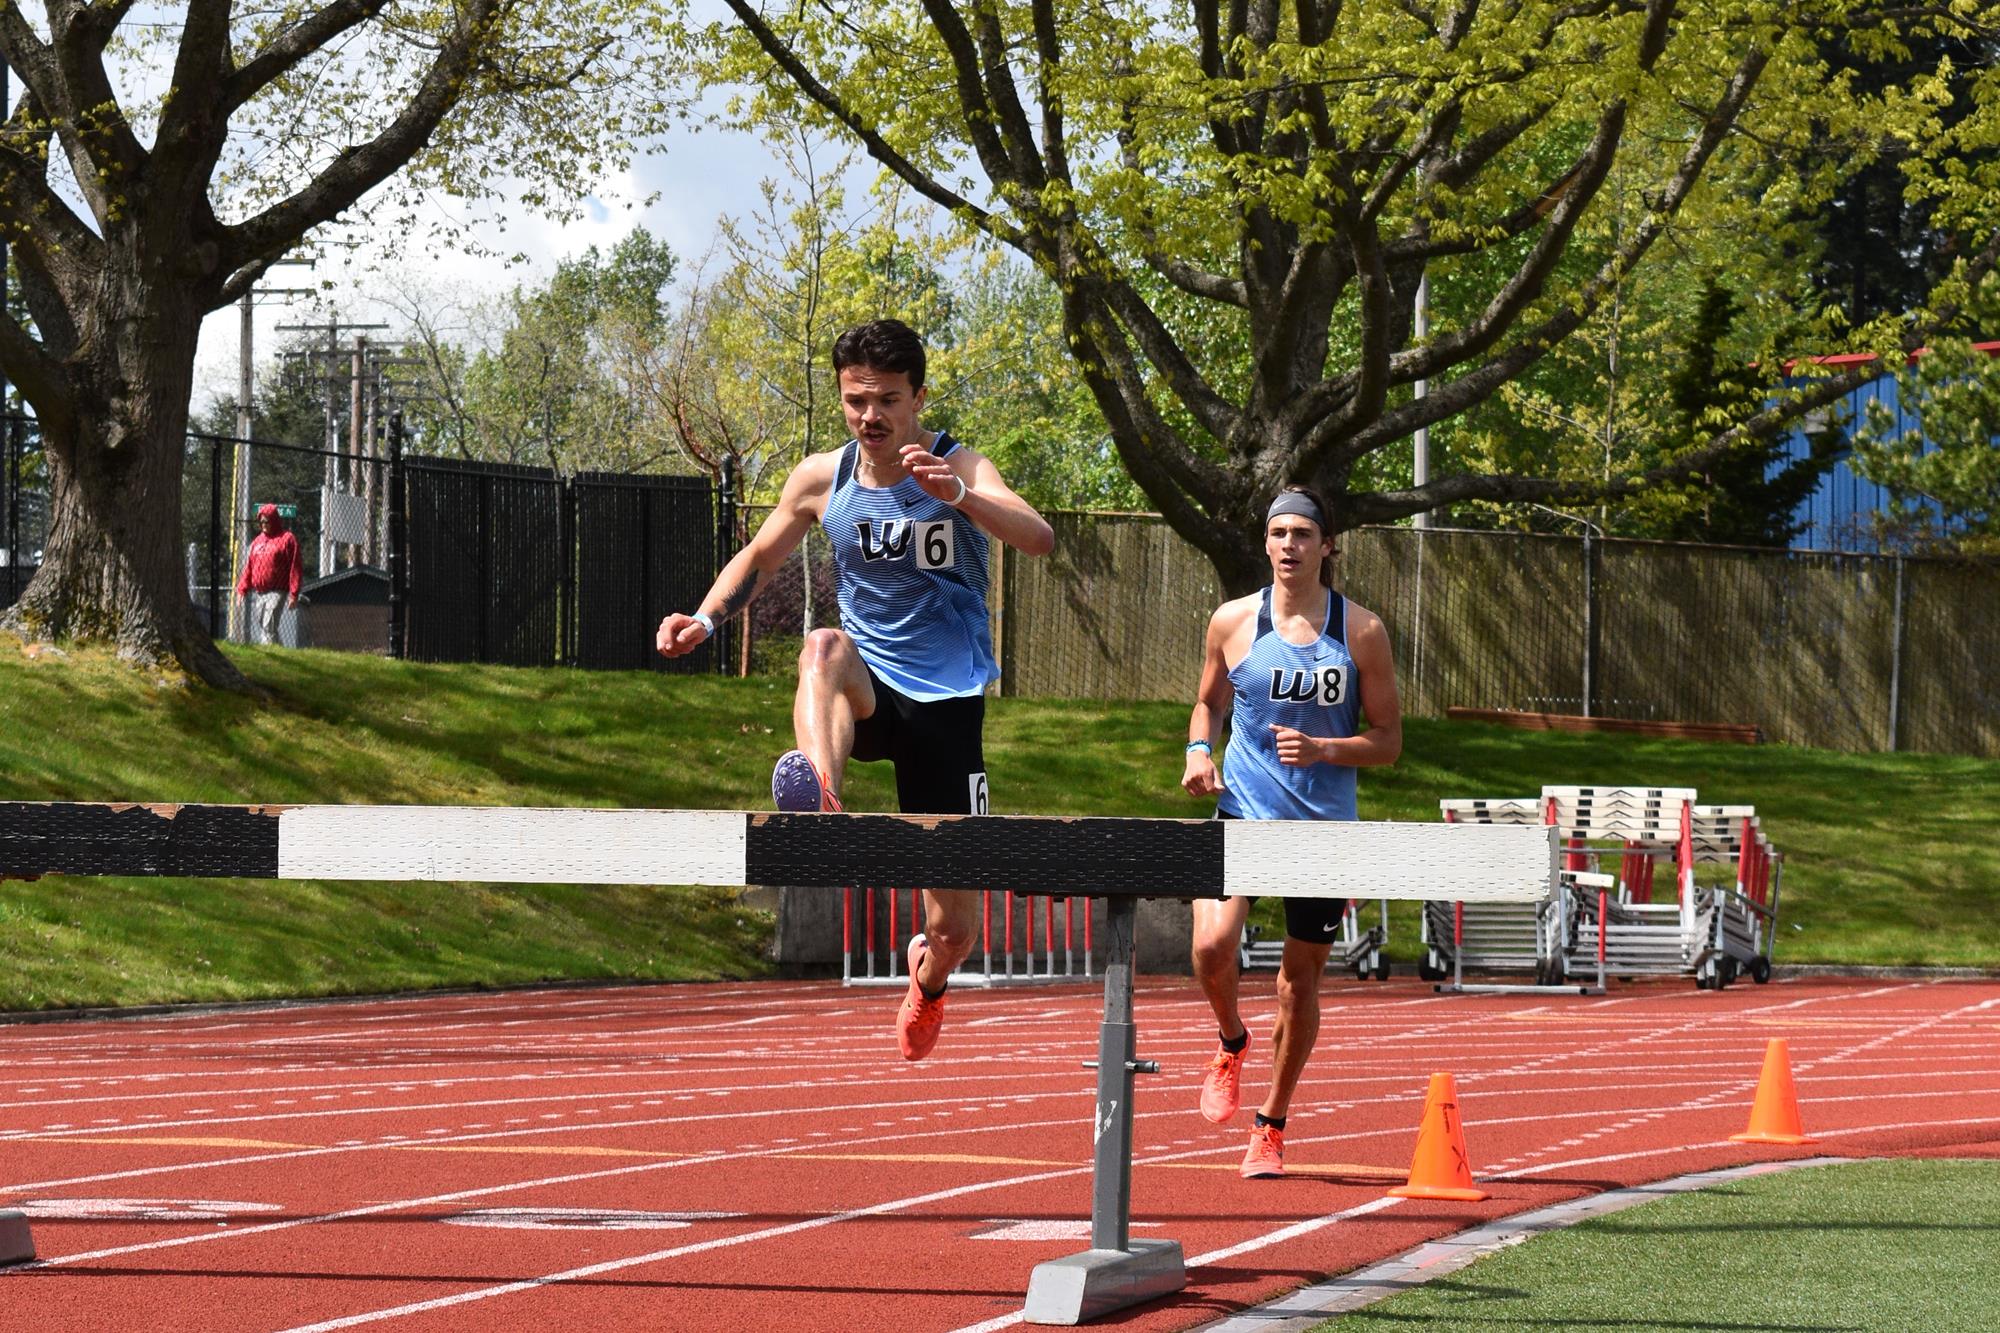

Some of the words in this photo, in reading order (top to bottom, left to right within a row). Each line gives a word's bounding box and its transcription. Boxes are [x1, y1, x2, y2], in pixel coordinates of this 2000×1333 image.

[853, 518, 916, 563] W
[925, 524, 948, 567] 6
[1323, 668, 1341, 703] 8
[976, 775, 987, 815] 6
